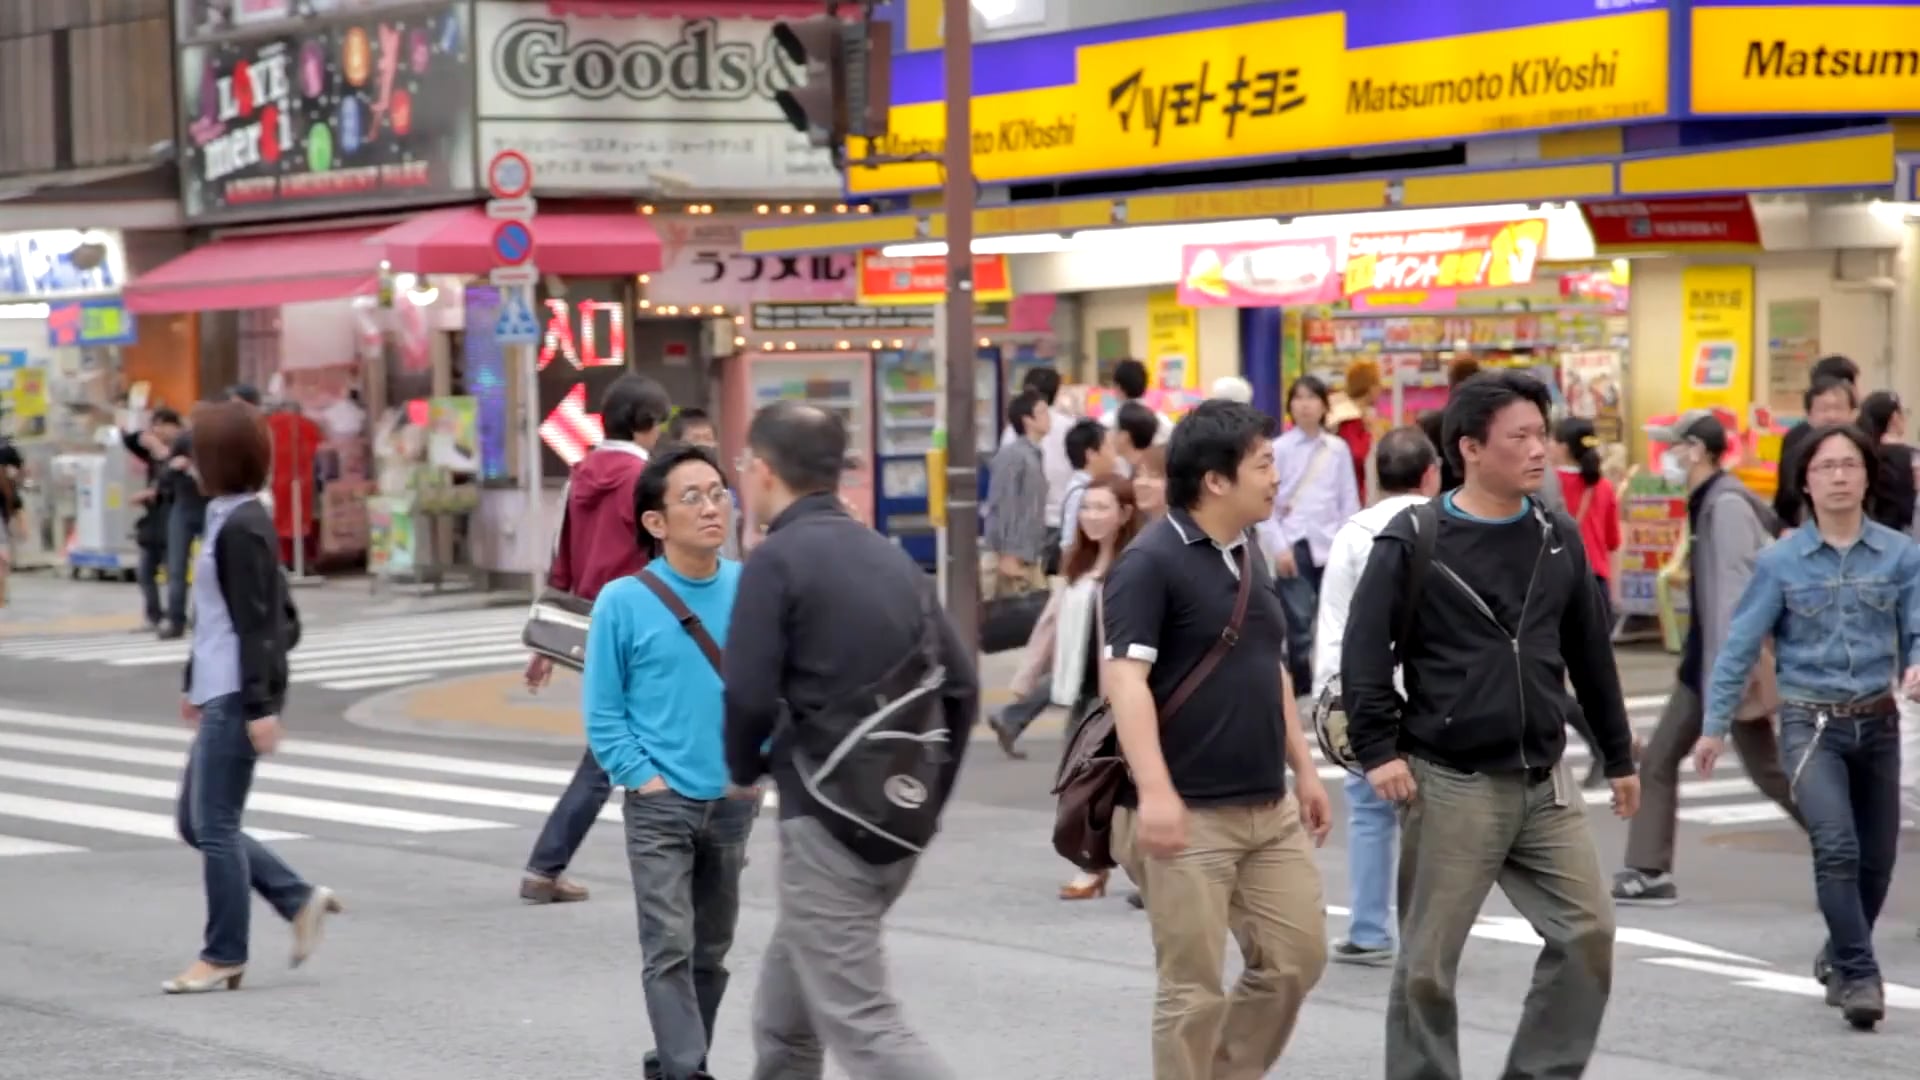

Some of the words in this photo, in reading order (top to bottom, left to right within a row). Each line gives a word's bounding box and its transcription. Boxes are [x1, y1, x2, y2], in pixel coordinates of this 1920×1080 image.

[493, 19, 755, 100] Goods
[1346, 71, 1503, 114] Matsumoto
[1508, 49, 1619, 97] KiYoshi
[1743, 39, 1919, 79] Matsum
[534, 298, 625, 371] 入口
